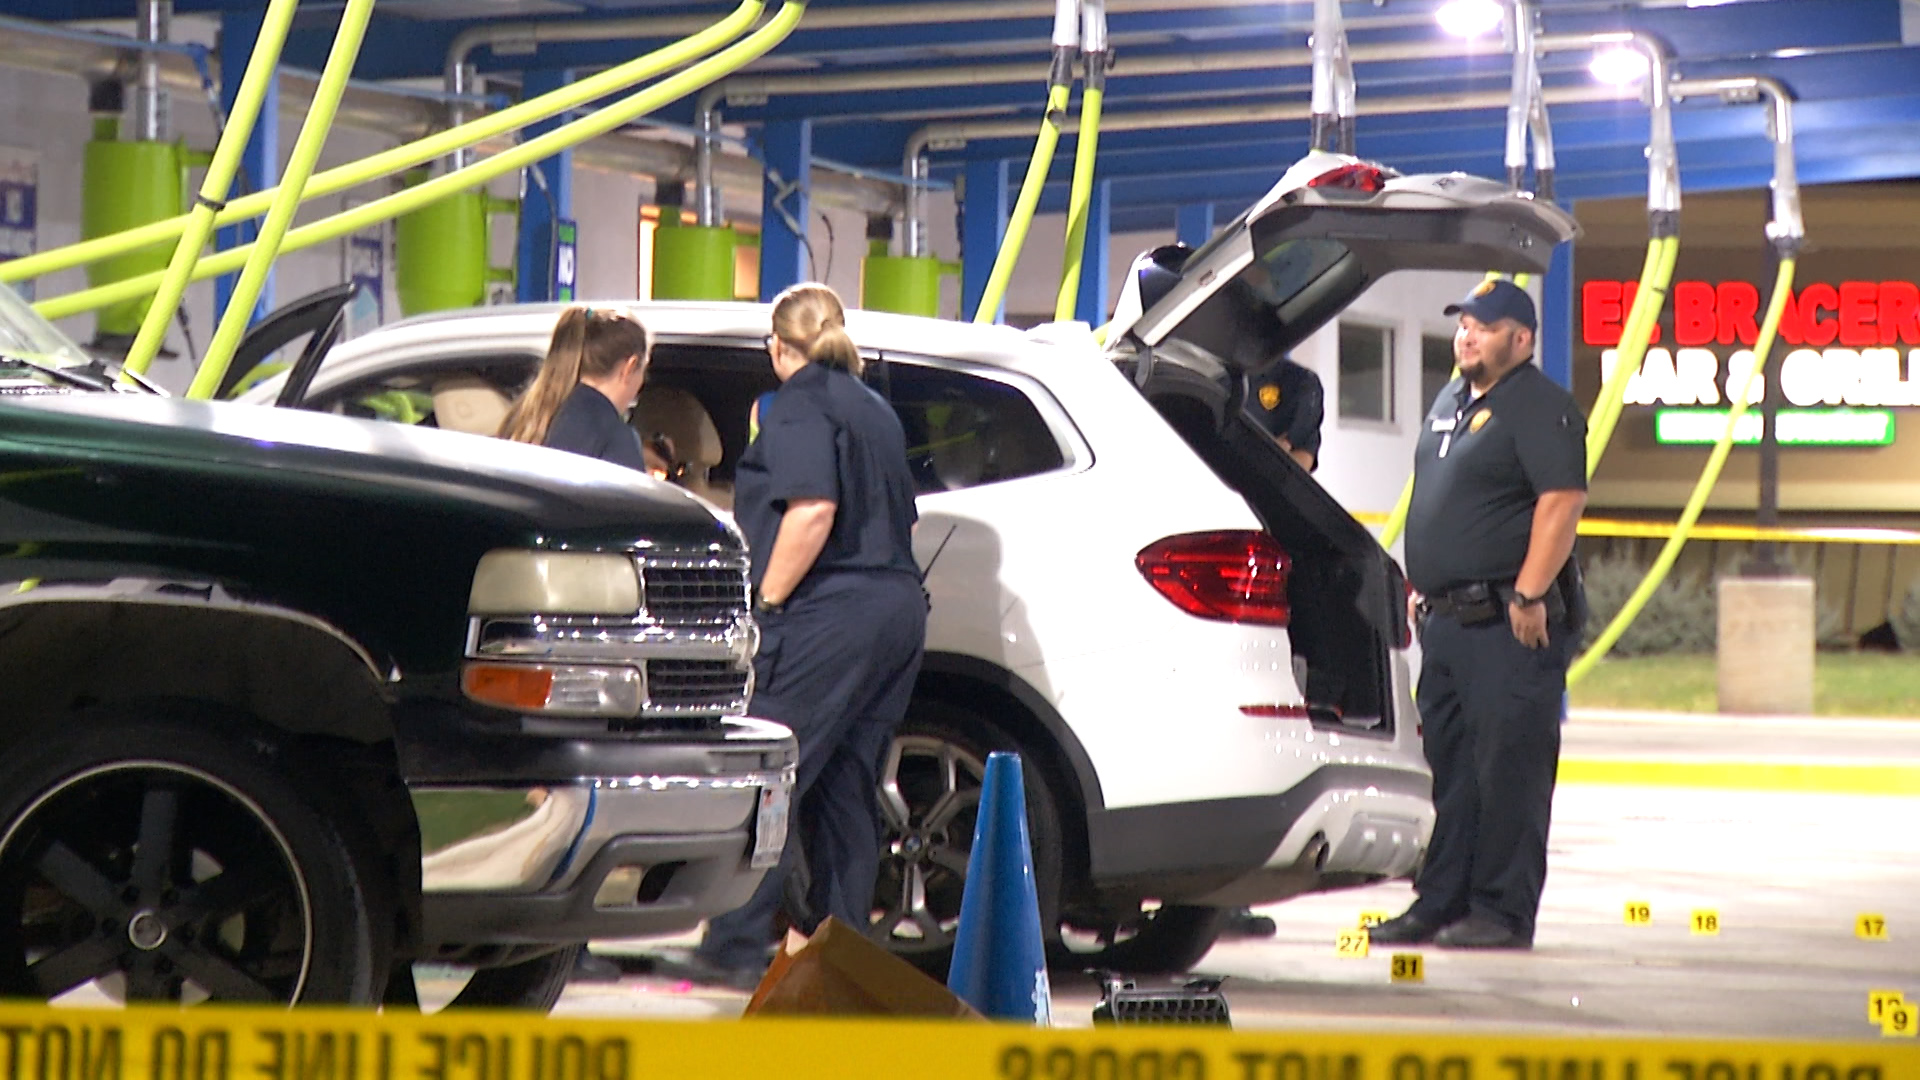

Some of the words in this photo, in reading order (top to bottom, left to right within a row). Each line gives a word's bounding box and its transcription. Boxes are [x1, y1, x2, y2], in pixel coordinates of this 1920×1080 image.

[1674, 280, 1920, 346] BRCER
[1628, 907, 1650, 922] 19
[1695, 915, 1717, 931] 18
[1864, 919, 1885, 936] 17
[1340, 935, 1364, 952] 27
[1393, 959, 1418, 977] 31
[1893, 1010, 1908, 1031] 9
